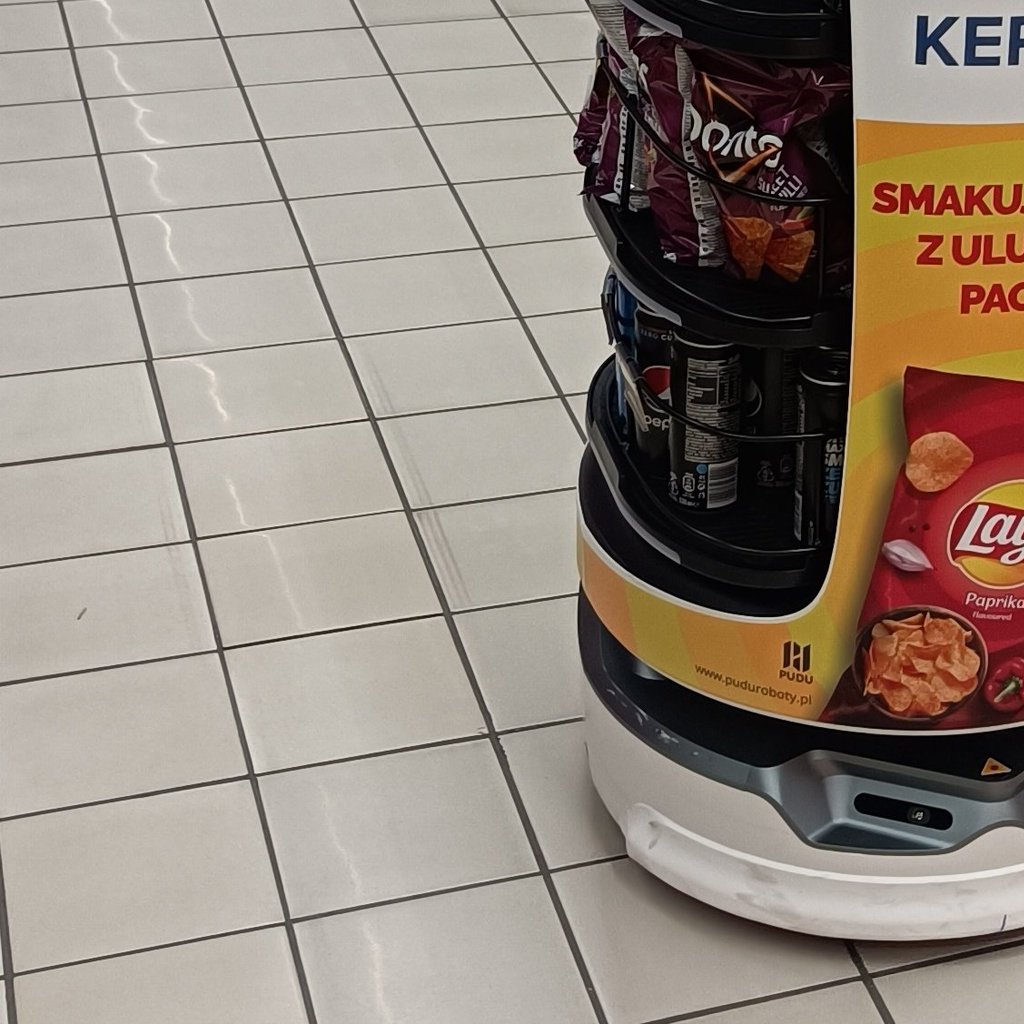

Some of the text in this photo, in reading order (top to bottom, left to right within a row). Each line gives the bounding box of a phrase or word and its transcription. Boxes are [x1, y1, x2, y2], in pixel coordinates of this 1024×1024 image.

[916, 233, 945, 266] Z
[972, 610, 1013, 622] flavoured
[695, 663, 813, 706] www.puduroboty.pl
[779, 669, 814, 685] PUDU
